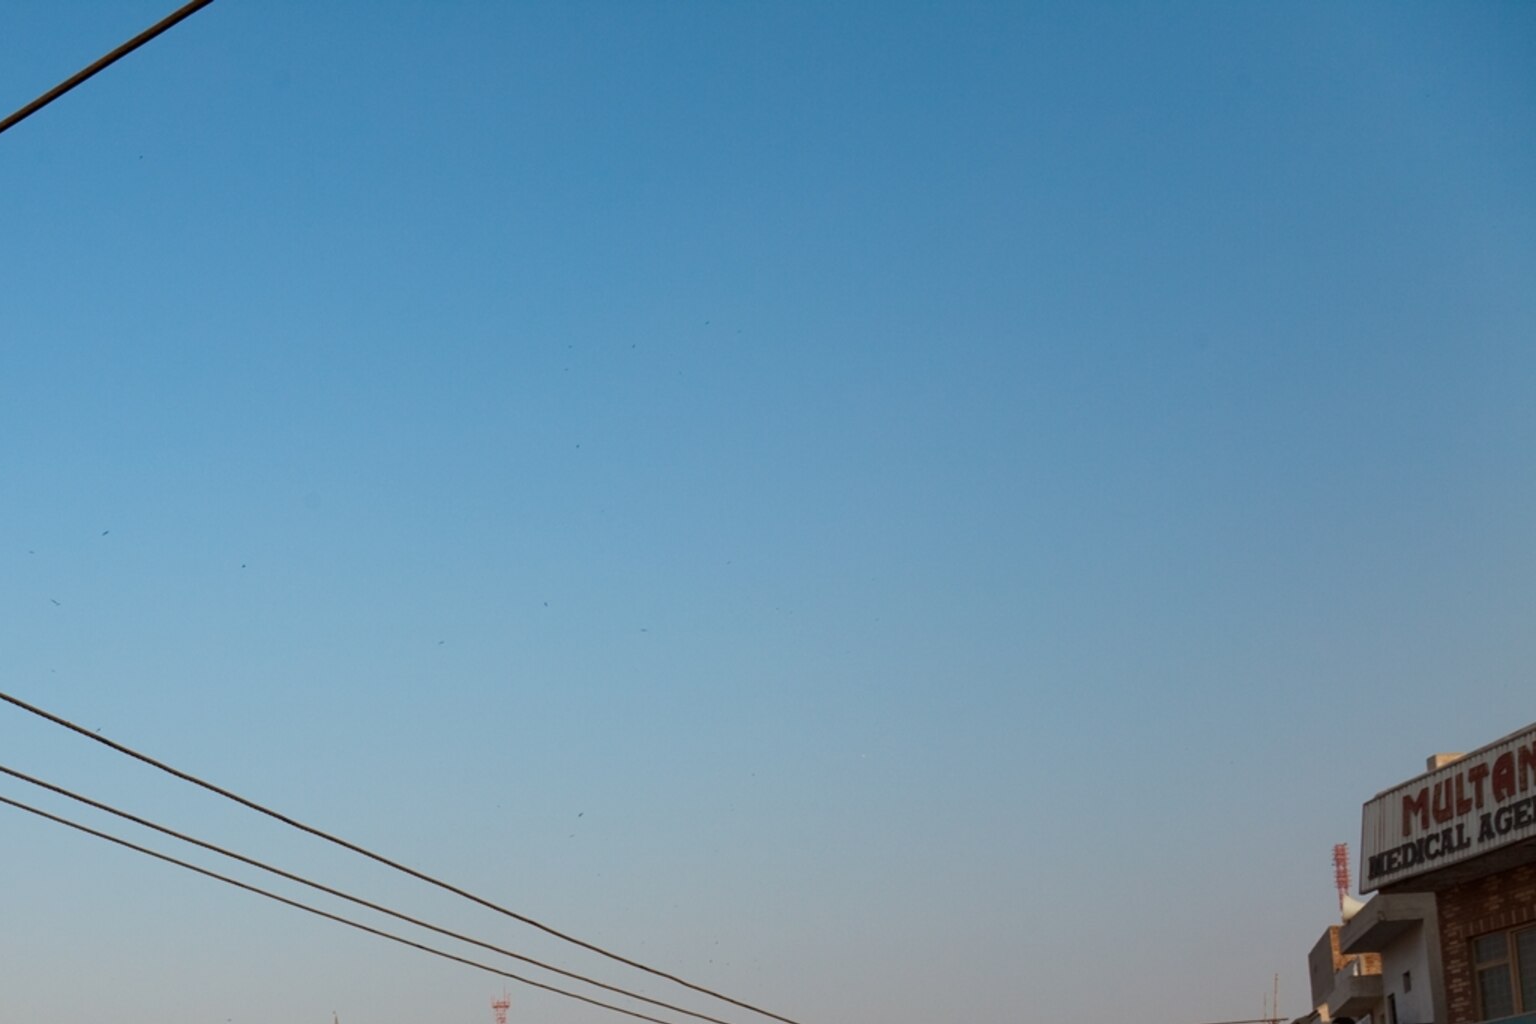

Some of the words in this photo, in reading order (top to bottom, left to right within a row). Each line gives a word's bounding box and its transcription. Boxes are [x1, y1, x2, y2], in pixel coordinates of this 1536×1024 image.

[1401, 740, 1536, 838] MULTAN
[1367, 823, 1471, 881] MEDICAL
[1478, 796, 1536, 844] AGE
